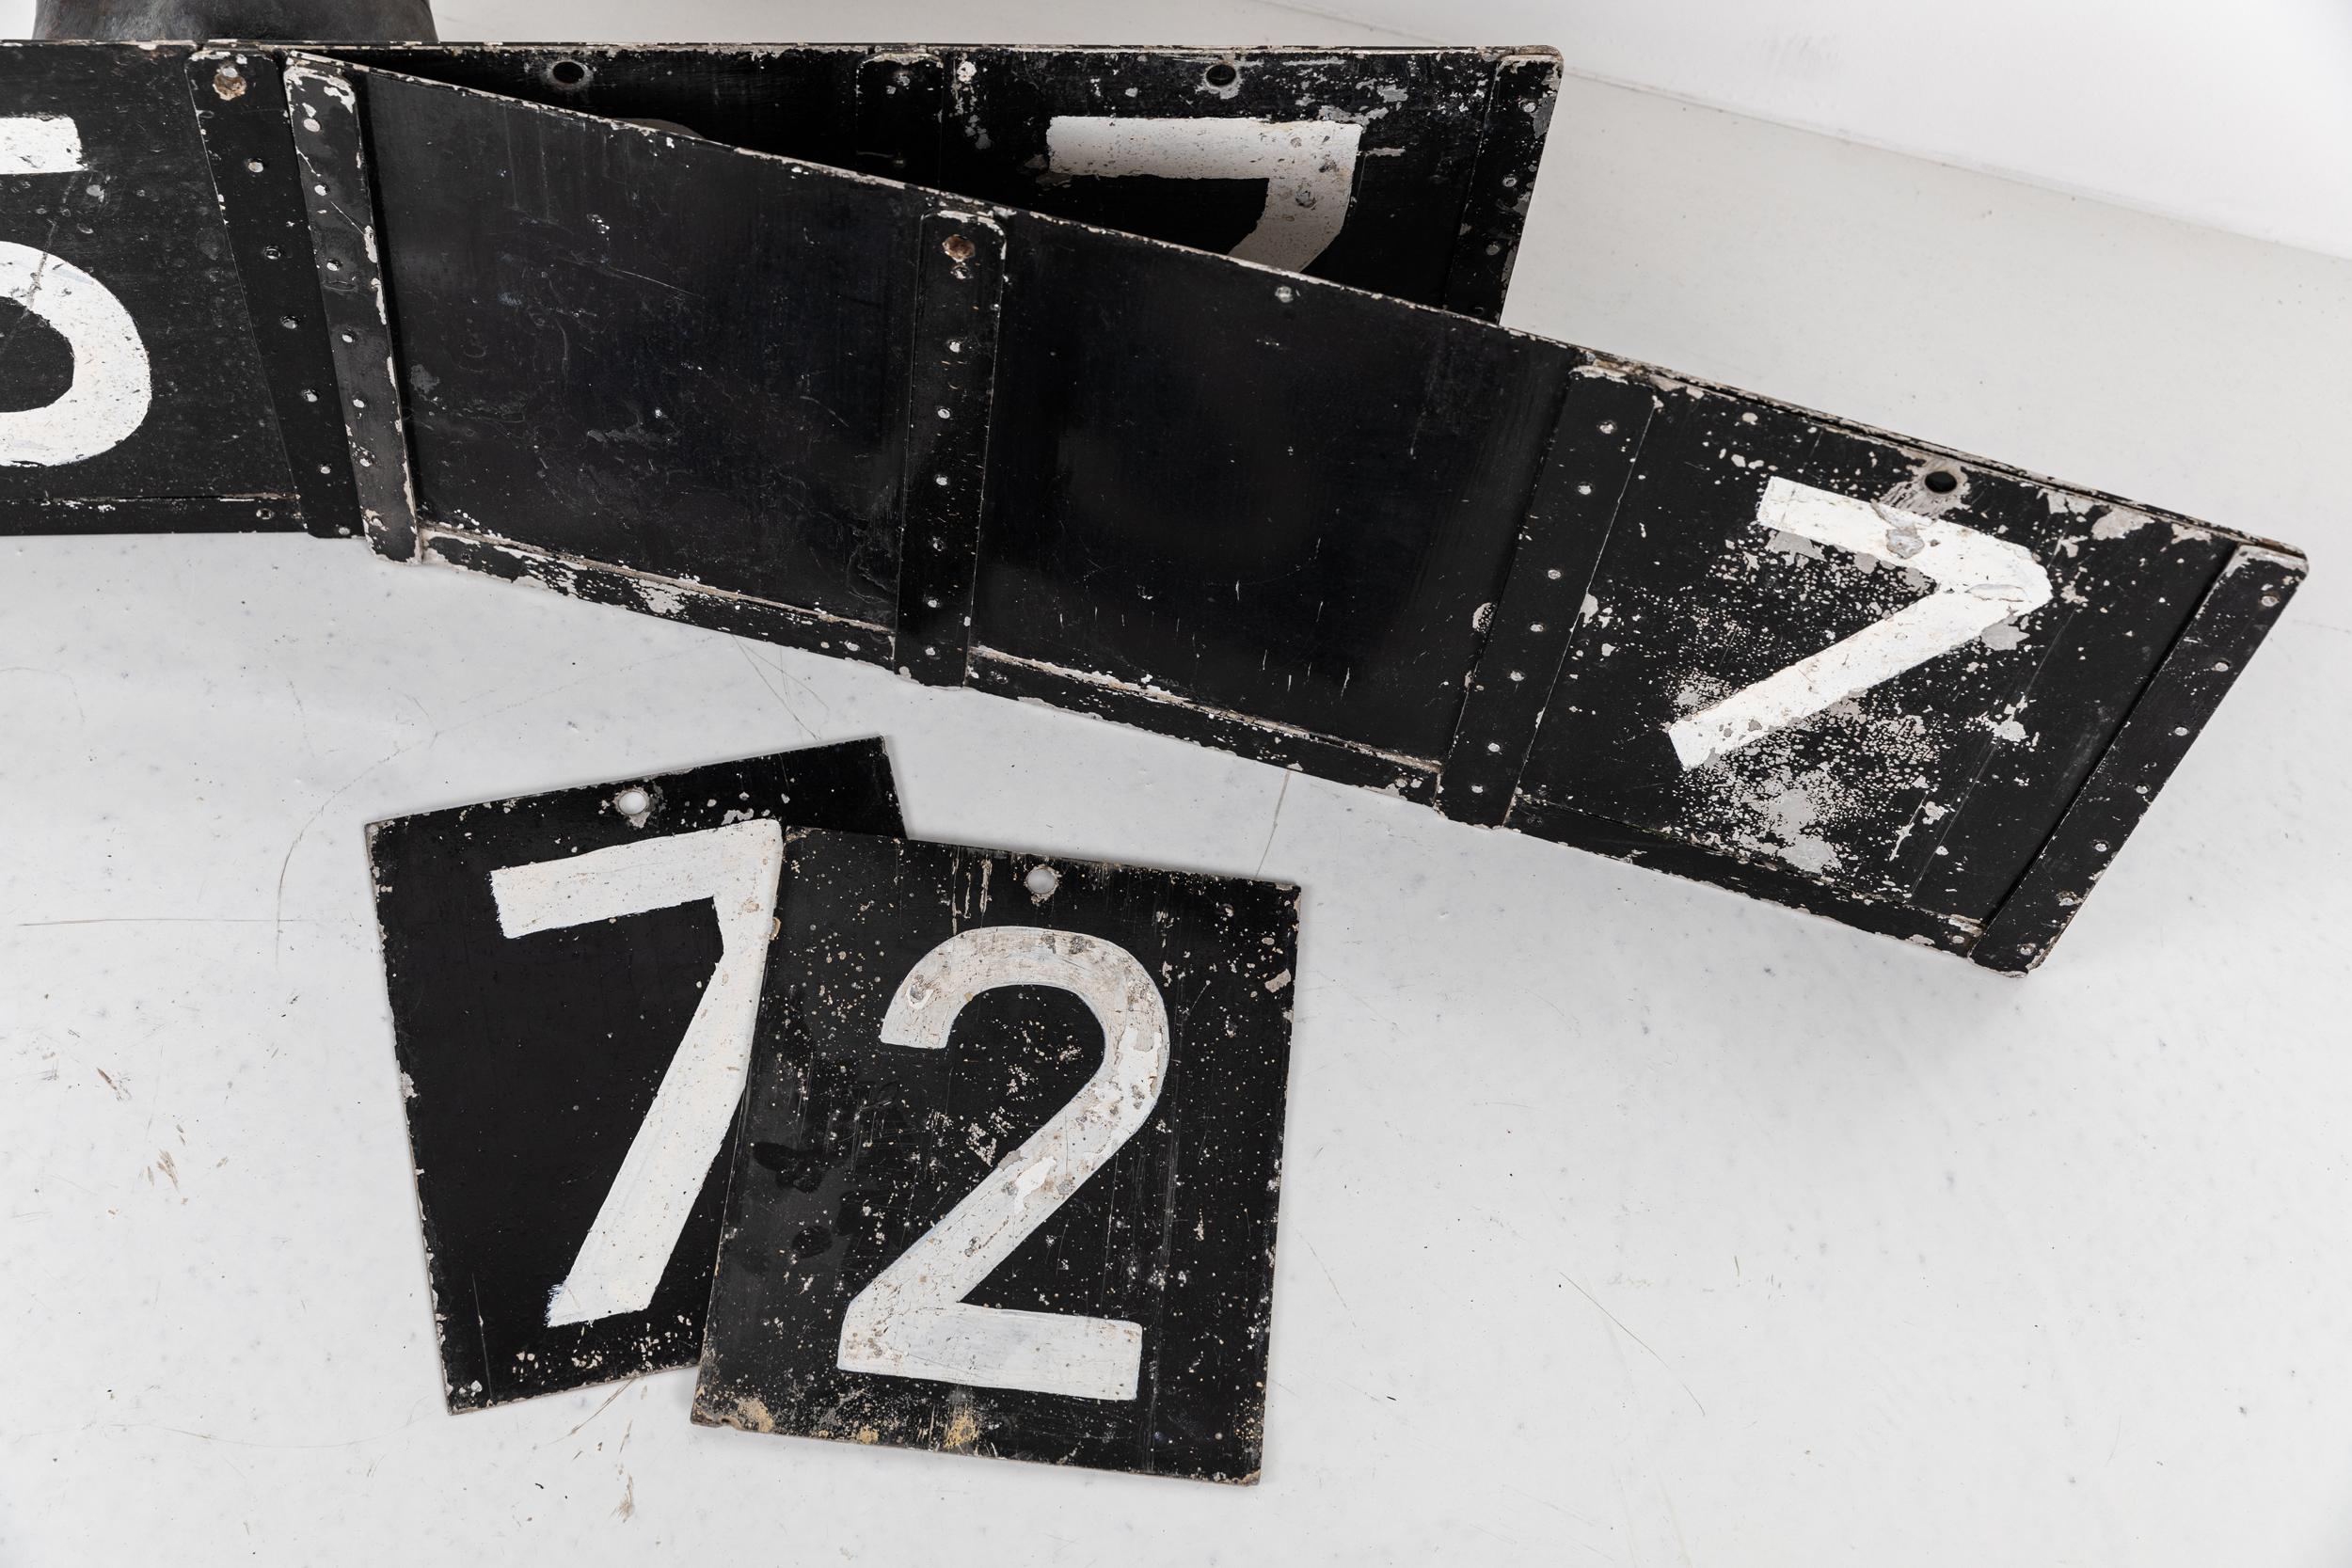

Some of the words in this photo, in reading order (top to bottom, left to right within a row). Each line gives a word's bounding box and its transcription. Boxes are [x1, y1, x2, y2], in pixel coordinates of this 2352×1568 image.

[1669, 476, 2054, 768] 7
[490, 818, 783, 1327] 7
[838, 926, 1168, 1401] 2
